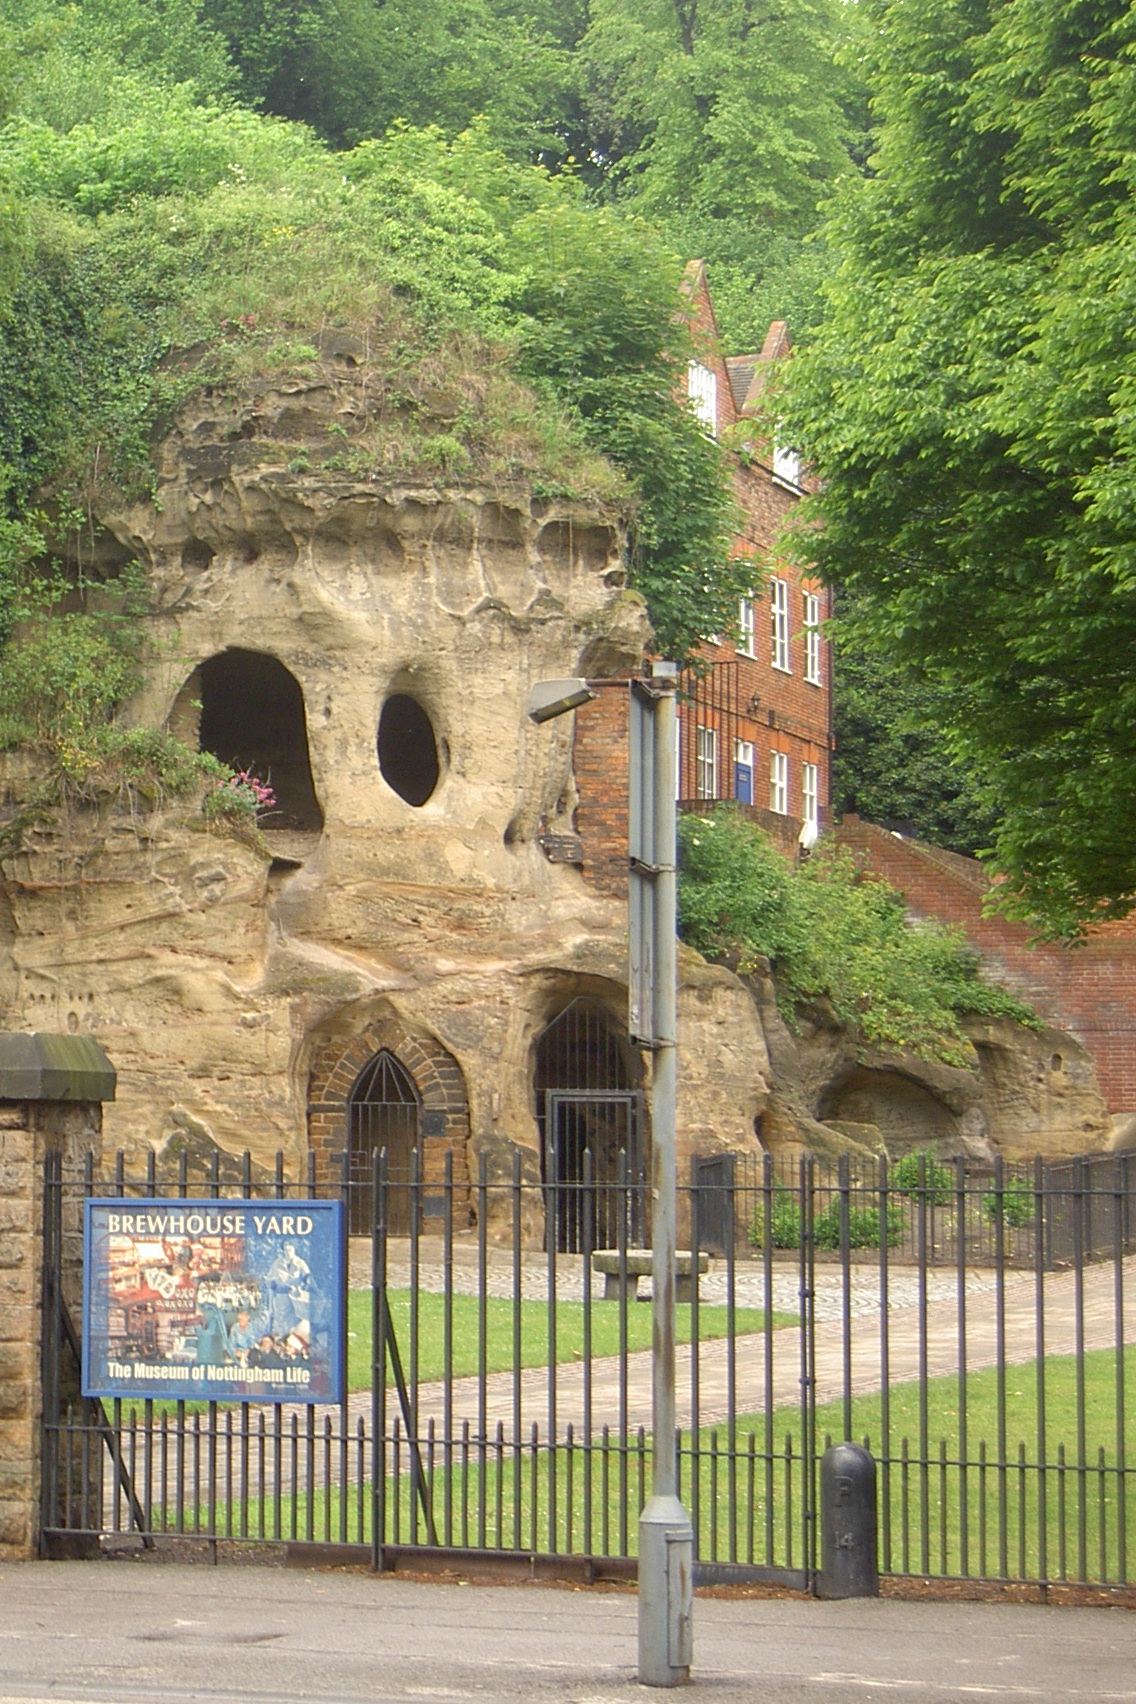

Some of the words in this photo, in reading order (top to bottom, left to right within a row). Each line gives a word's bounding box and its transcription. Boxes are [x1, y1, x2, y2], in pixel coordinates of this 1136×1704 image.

[108, 1214, 245, 1235] BREWHOUSE
[253, 1216, 313, 1235] YARD
[107, 1362, 131, 1378] The
[133, 1362, 189, 1379] Museum
[191, 1364, 205, 1380] of
[207, 1364, 284, 1383] Nottingham
[286, 1366, 310, 1383] Life
